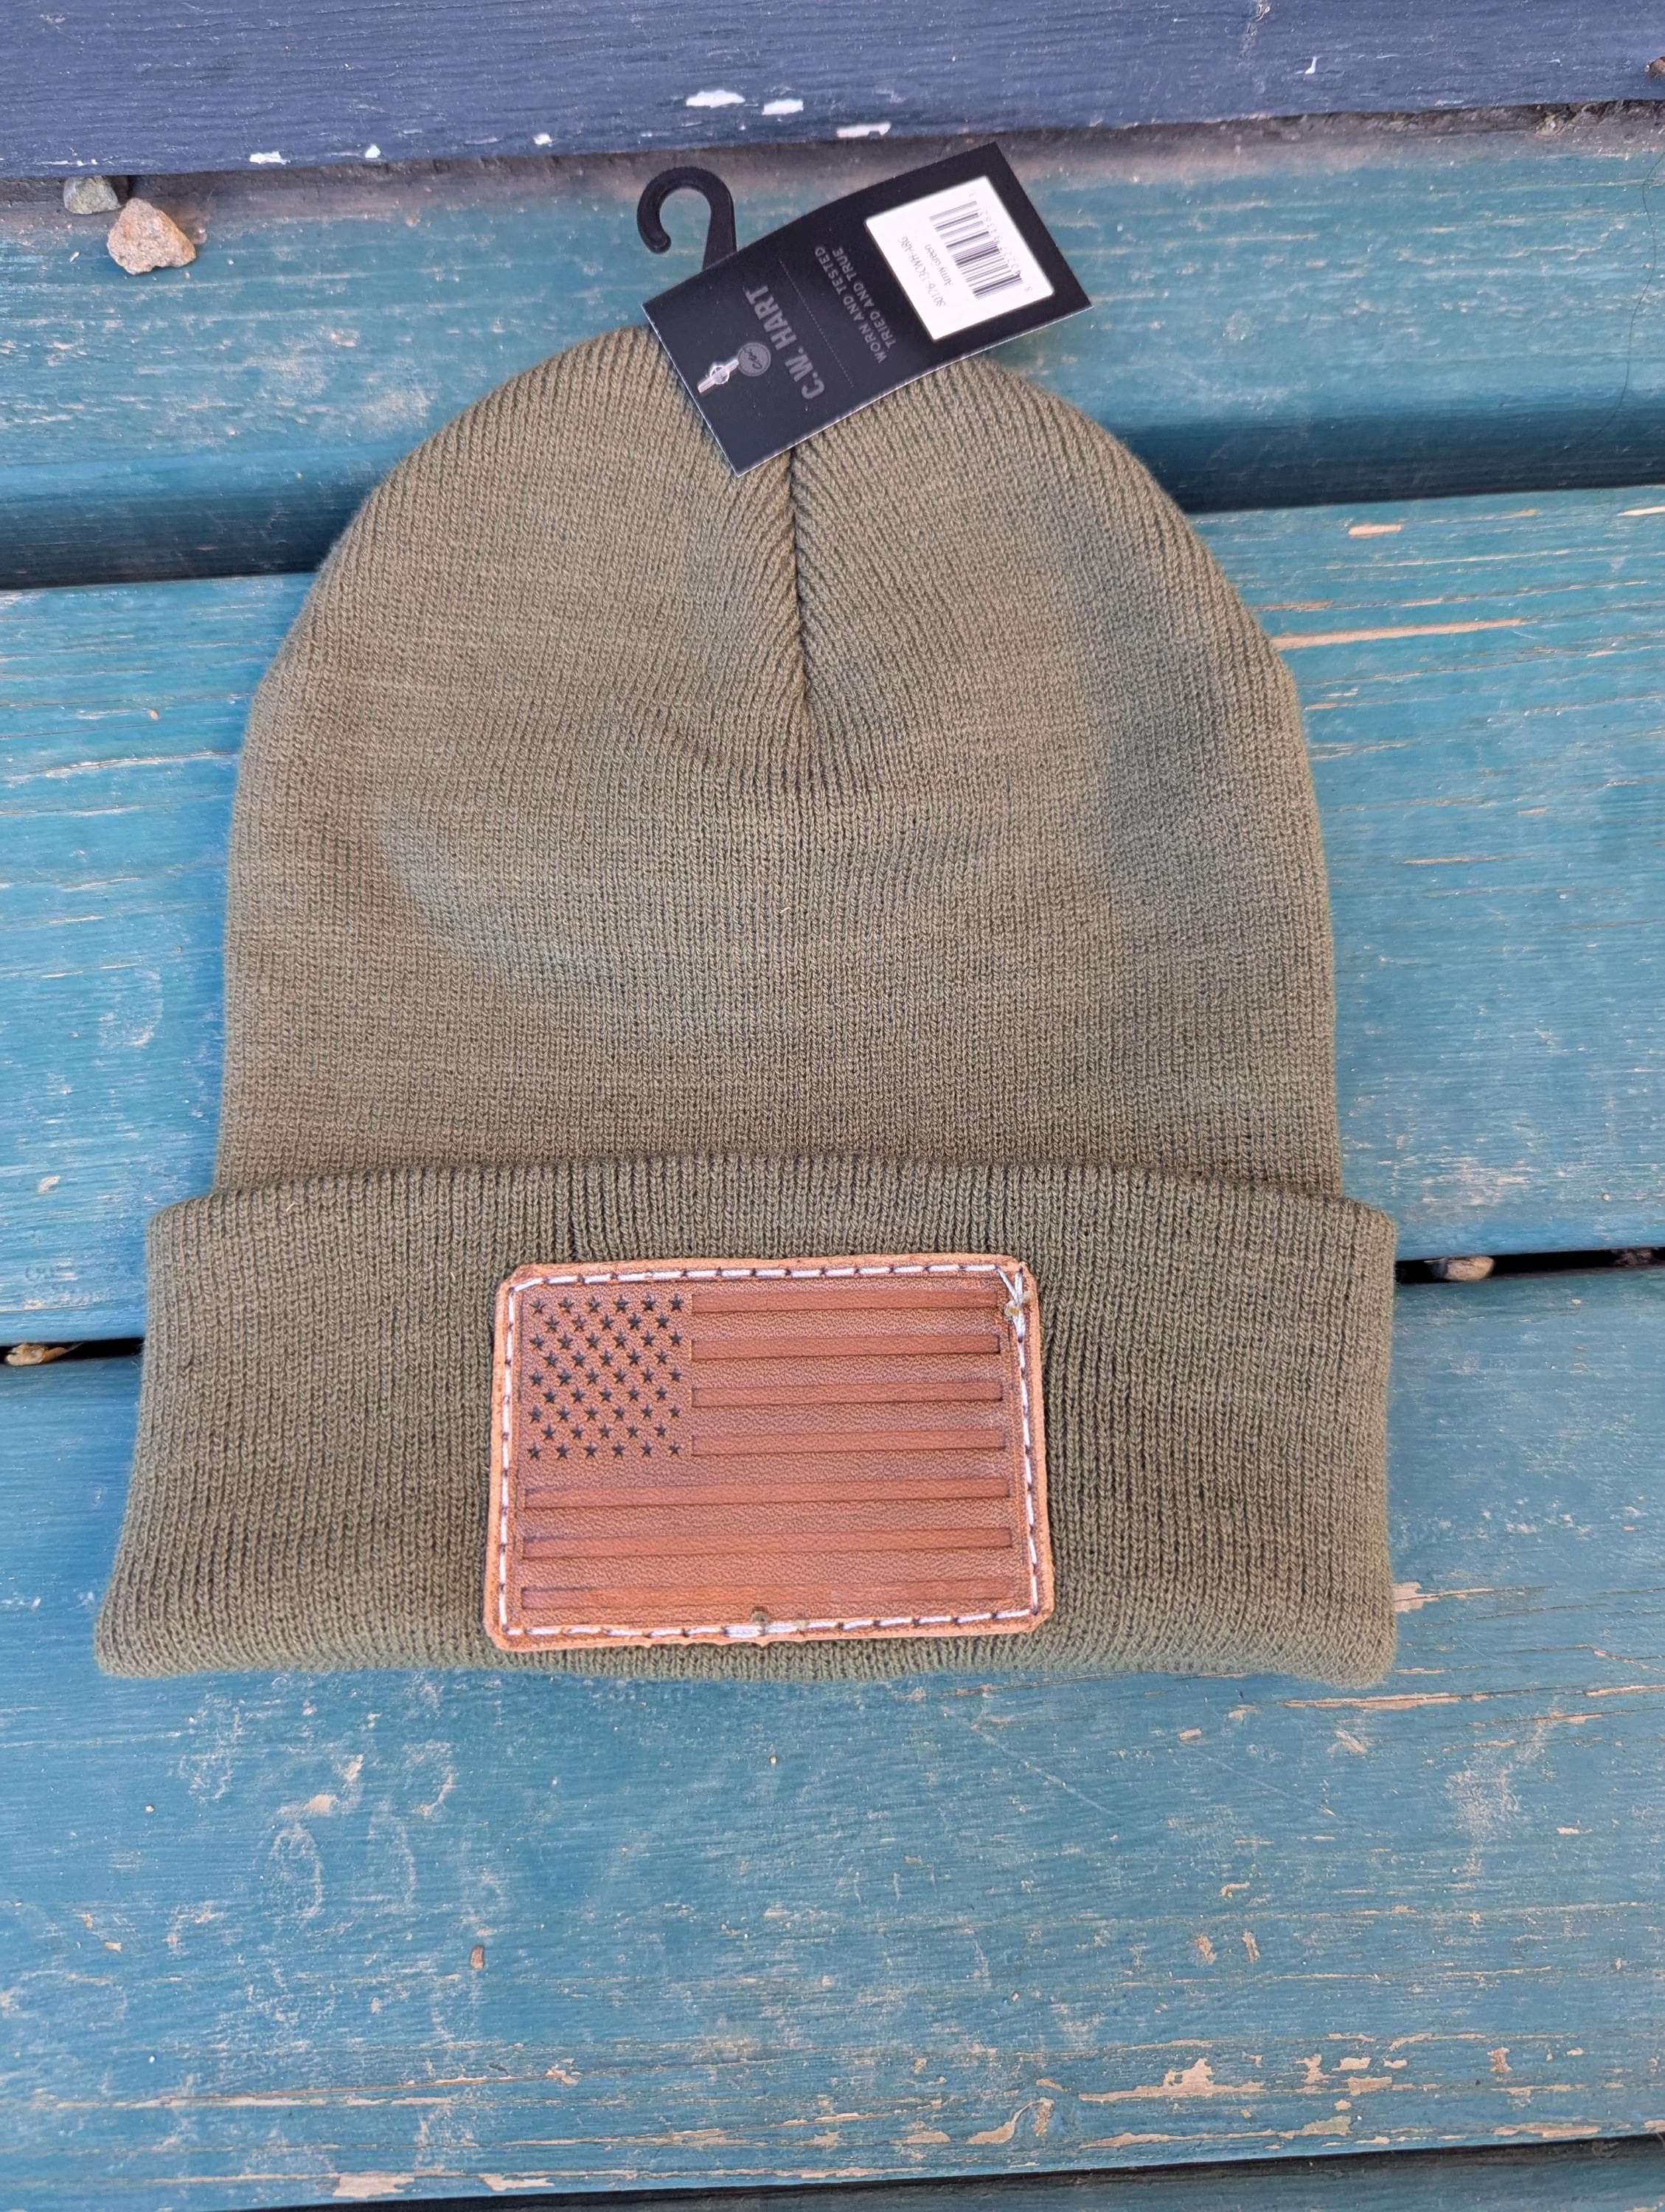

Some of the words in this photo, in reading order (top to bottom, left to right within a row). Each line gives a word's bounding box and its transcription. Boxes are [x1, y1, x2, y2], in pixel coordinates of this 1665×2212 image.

[813, 244, 847, 294] TESTED
[832, 246, 858, 281] TRUE
[923, 243, 942, 267] Green
[937, 267, 953, 285] Army
[841, 293, 865, 322] AND
[852, 280, 875, 310] AND
[745, 286, 796, 349] HART
[869, 309, 897, 348] TRIED
[857, 321, 888, 364] WORN
[784, 348, 826, 399] C.W.
